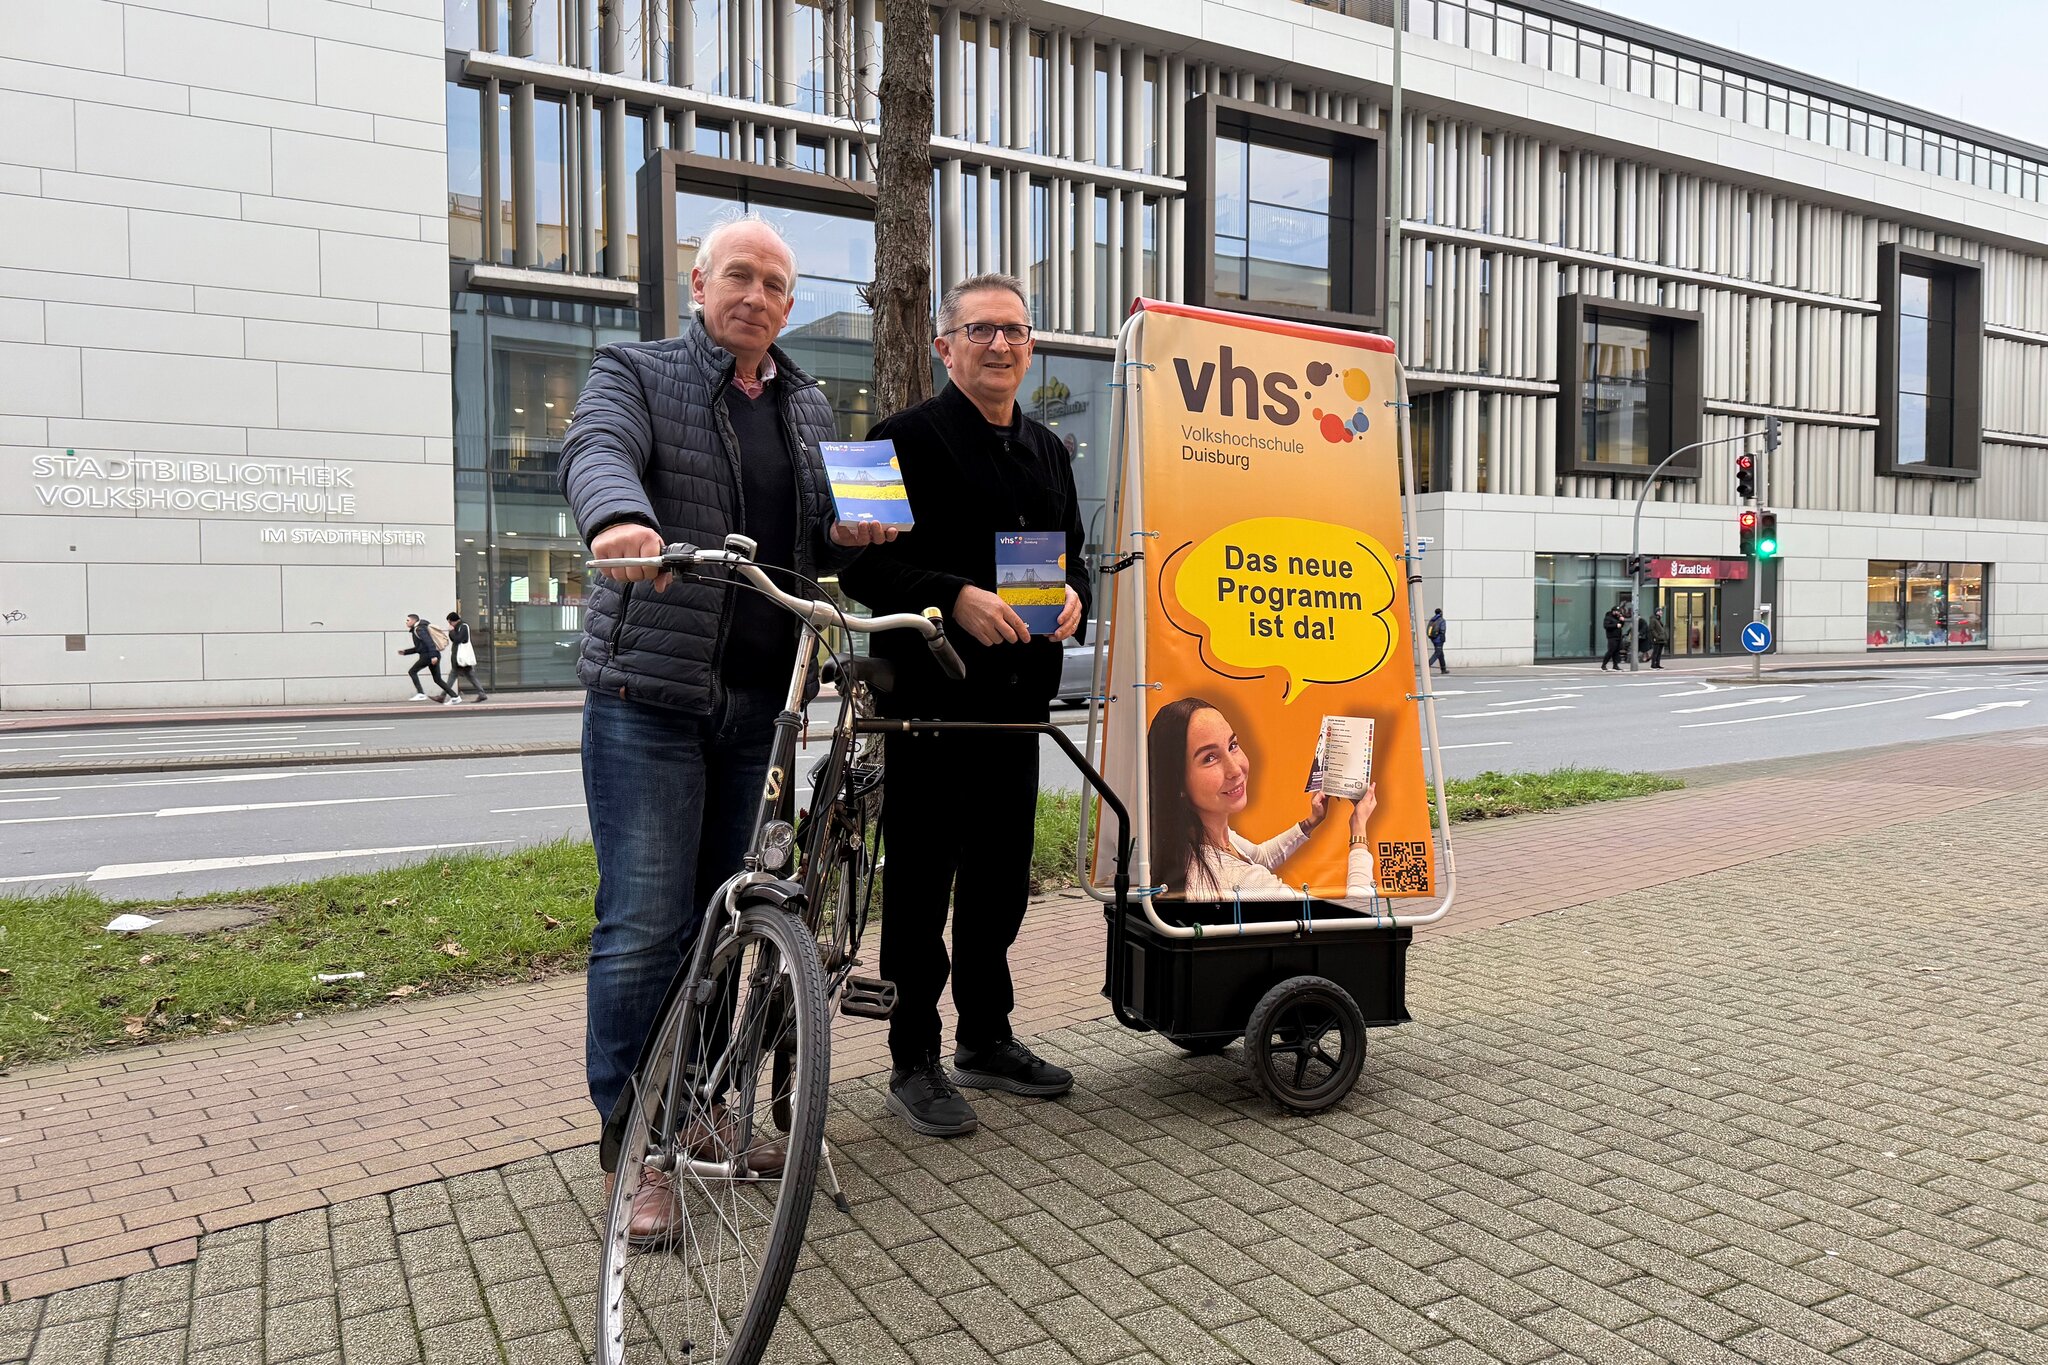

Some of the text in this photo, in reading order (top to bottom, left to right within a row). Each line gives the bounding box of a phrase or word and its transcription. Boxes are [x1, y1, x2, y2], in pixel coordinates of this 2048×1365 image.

[1173, 345, 1300, 426] vhs
[1181, 424, 1304, 454] Volkshochschule
[33, 456, 354, 488] STADTBIBLIOTHEK
[1182, 445, 1250, 471] Duisburg
[34, 485, 355, 515] VOLKSHOCHSCHULE
[260, 527, 426, 546] IM STADTFENSTER
[1000, 536, 1014, 544] vhs
[1225, 545, 1353, 579] Das neue
[1678, 564, 1711, 575] Ziraat Bank
[1218, 577, 1362, 612] Programm
[1250, 611, 1335, 640] ist da!
